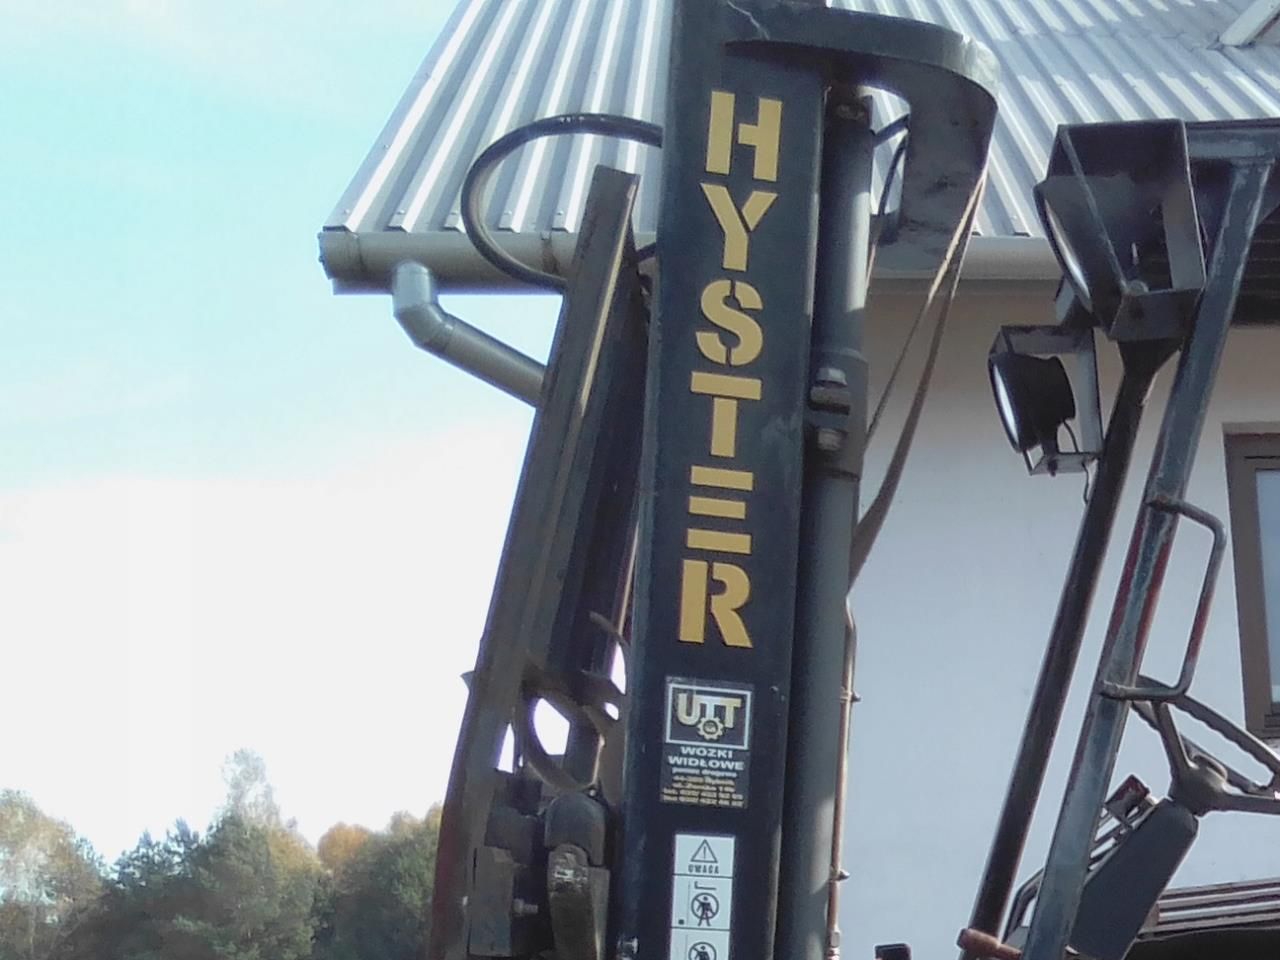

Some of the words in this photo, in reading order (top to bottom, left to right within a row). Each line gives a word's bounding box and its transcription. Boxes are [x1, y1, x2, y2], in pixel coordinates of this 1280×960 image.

[677, 91, 783, 648] HYSTER
[676, 692, 742, 729] UTT
[667, 755, 745, 771] WIDŁOWE
